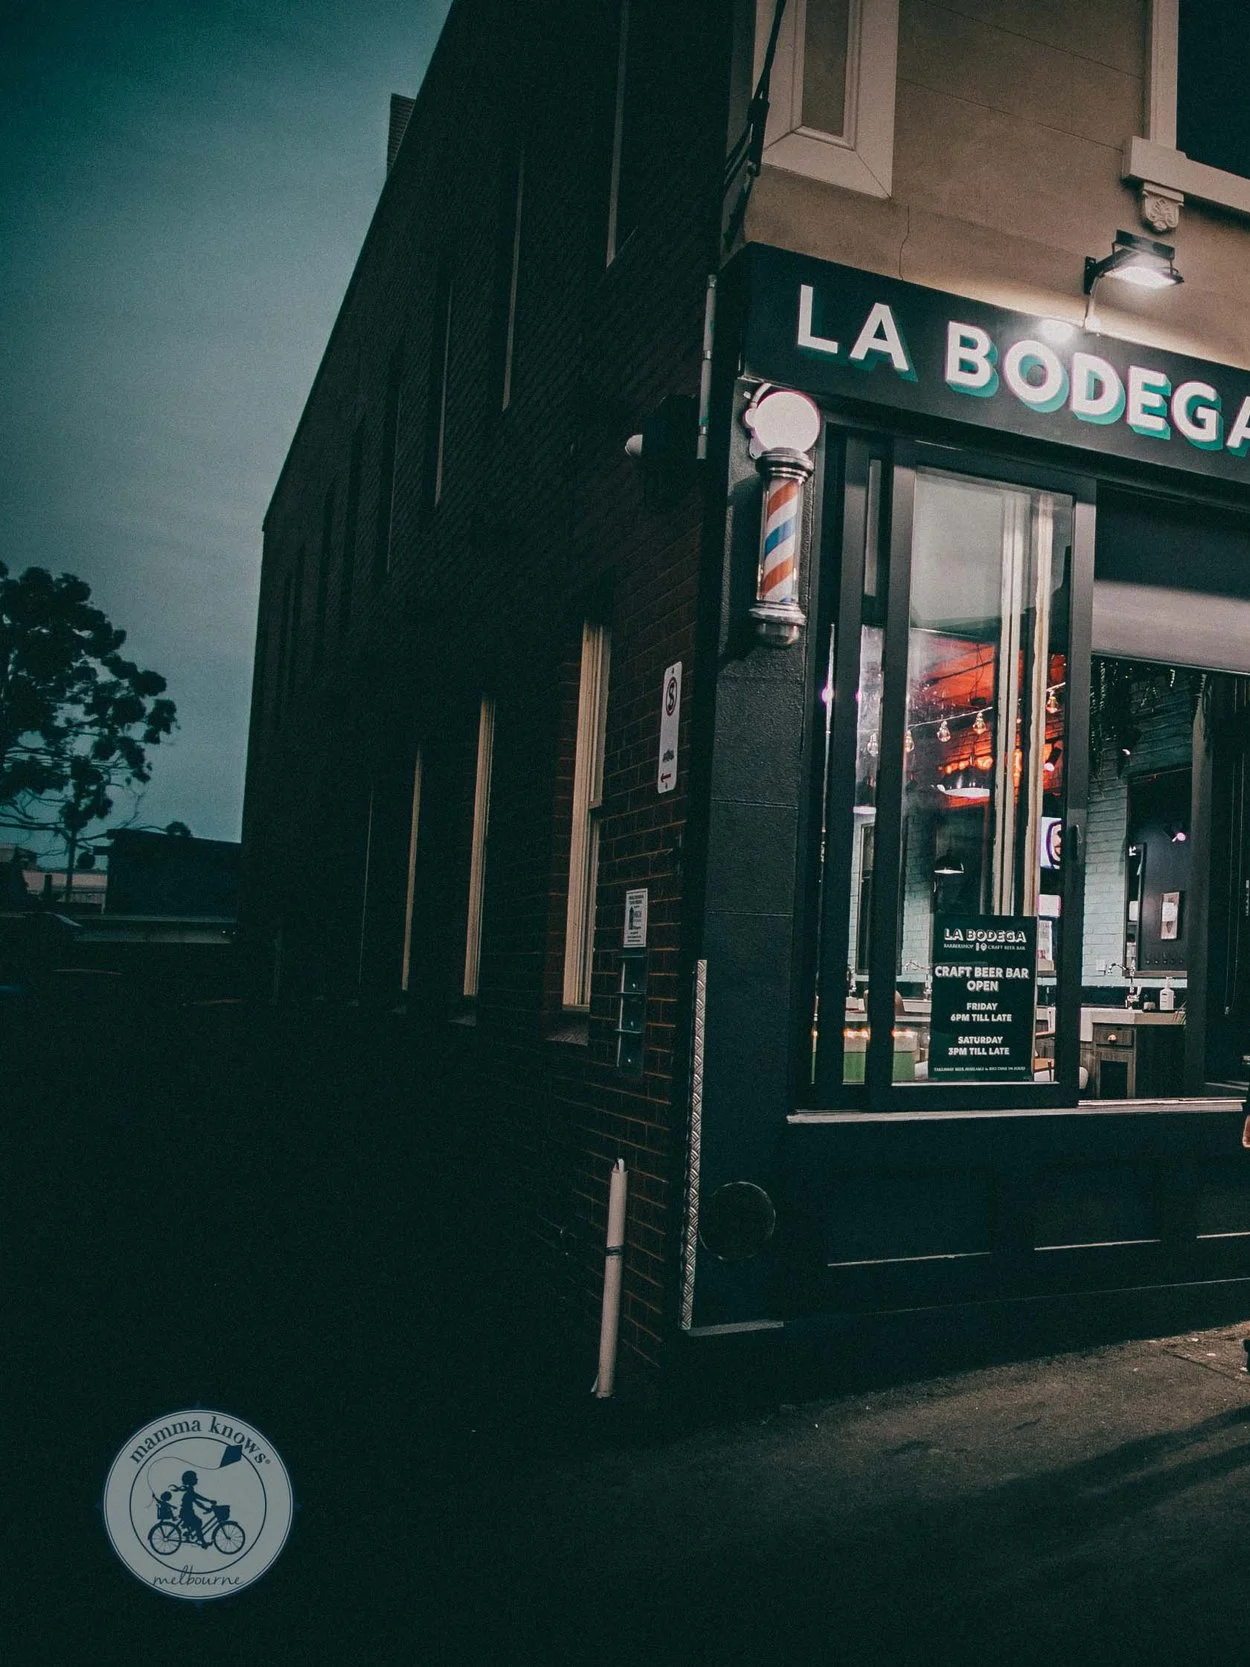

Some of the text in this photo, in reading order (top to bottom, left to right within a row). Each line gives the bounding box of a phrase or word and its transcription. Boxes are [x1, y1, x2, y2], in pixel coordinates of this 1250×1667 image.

[797, 284, 913, 375] LA
[944, 928, 1027, 943] LA BODEGA
[934, 966, 1029, 979] CRAFT BEER BAR
[966, 980, 999, 992] OPEN
[966, 1002, 998, 1011] FRIDAY
[950, 1013, 1012, 1022] 6PM TILL LATE
[957, 1036, 1003, 1044] SATURDAY
[969, 1047, 987, 1056] TILL
[988, 1047, 1010, 1056] LATE
